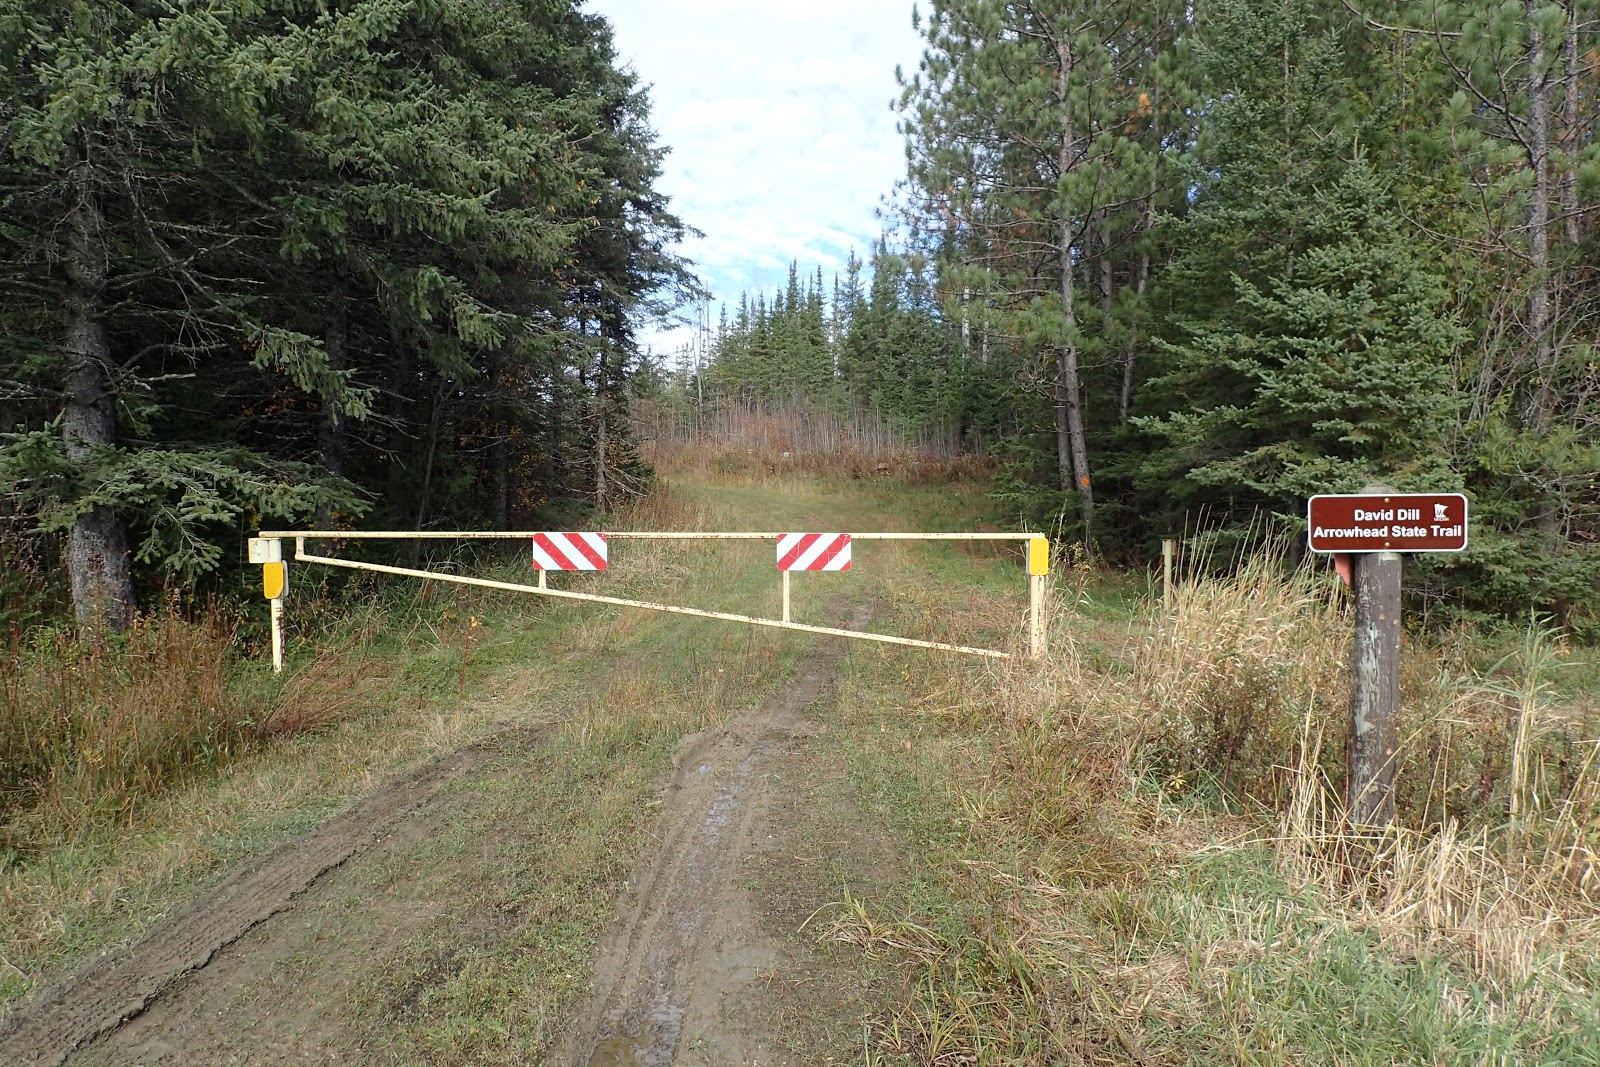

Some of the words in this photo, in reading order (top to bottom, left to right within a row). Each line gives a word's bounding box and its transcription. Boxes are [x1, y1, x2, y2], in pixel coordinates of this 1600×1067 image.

[1354, 509, 1393, 521] David
[1397, 509, 1420, 521] Dill
[1313, 526, 1388, 538] Arrowhead
[1391, 525, 1427, 537] State
[1430, 525, 1461, 537] Trail
